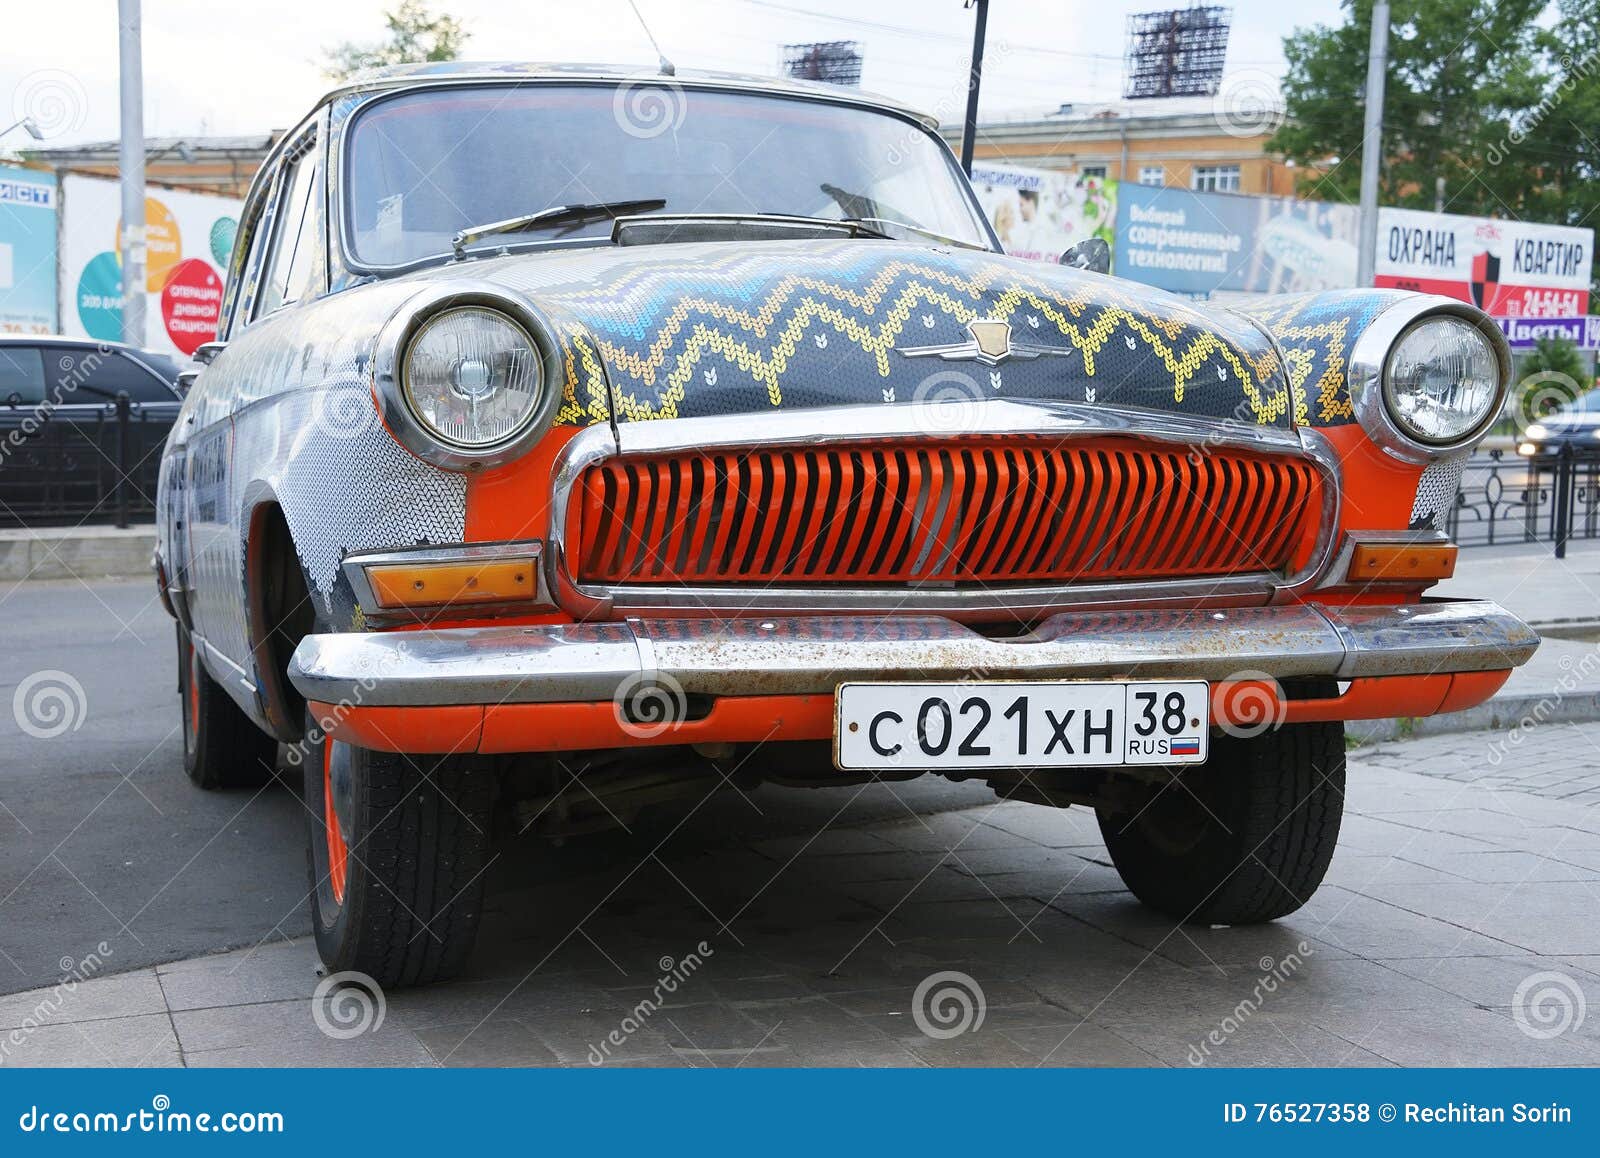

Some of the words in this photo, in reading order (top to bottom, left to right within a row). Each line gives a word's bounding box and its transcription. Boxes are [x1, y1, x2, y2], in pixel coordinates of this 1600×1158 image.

[1129, 203, 1186, 227] Выбирай
[1128, 225, 1241, 252] современные
[1388, 226, 1456, 268] ОХРАНА
[1513, 237, 1584, 277] КВАРТИР
[1127, 247, 1228, 273] технологии!
[1523, 289, 1579, 318] 24-54-54
[1497, 318, 1581, 342] Цветы
[1133, 691, 1186, 737] 38
[1129, 740, 1168, 755] RUS
